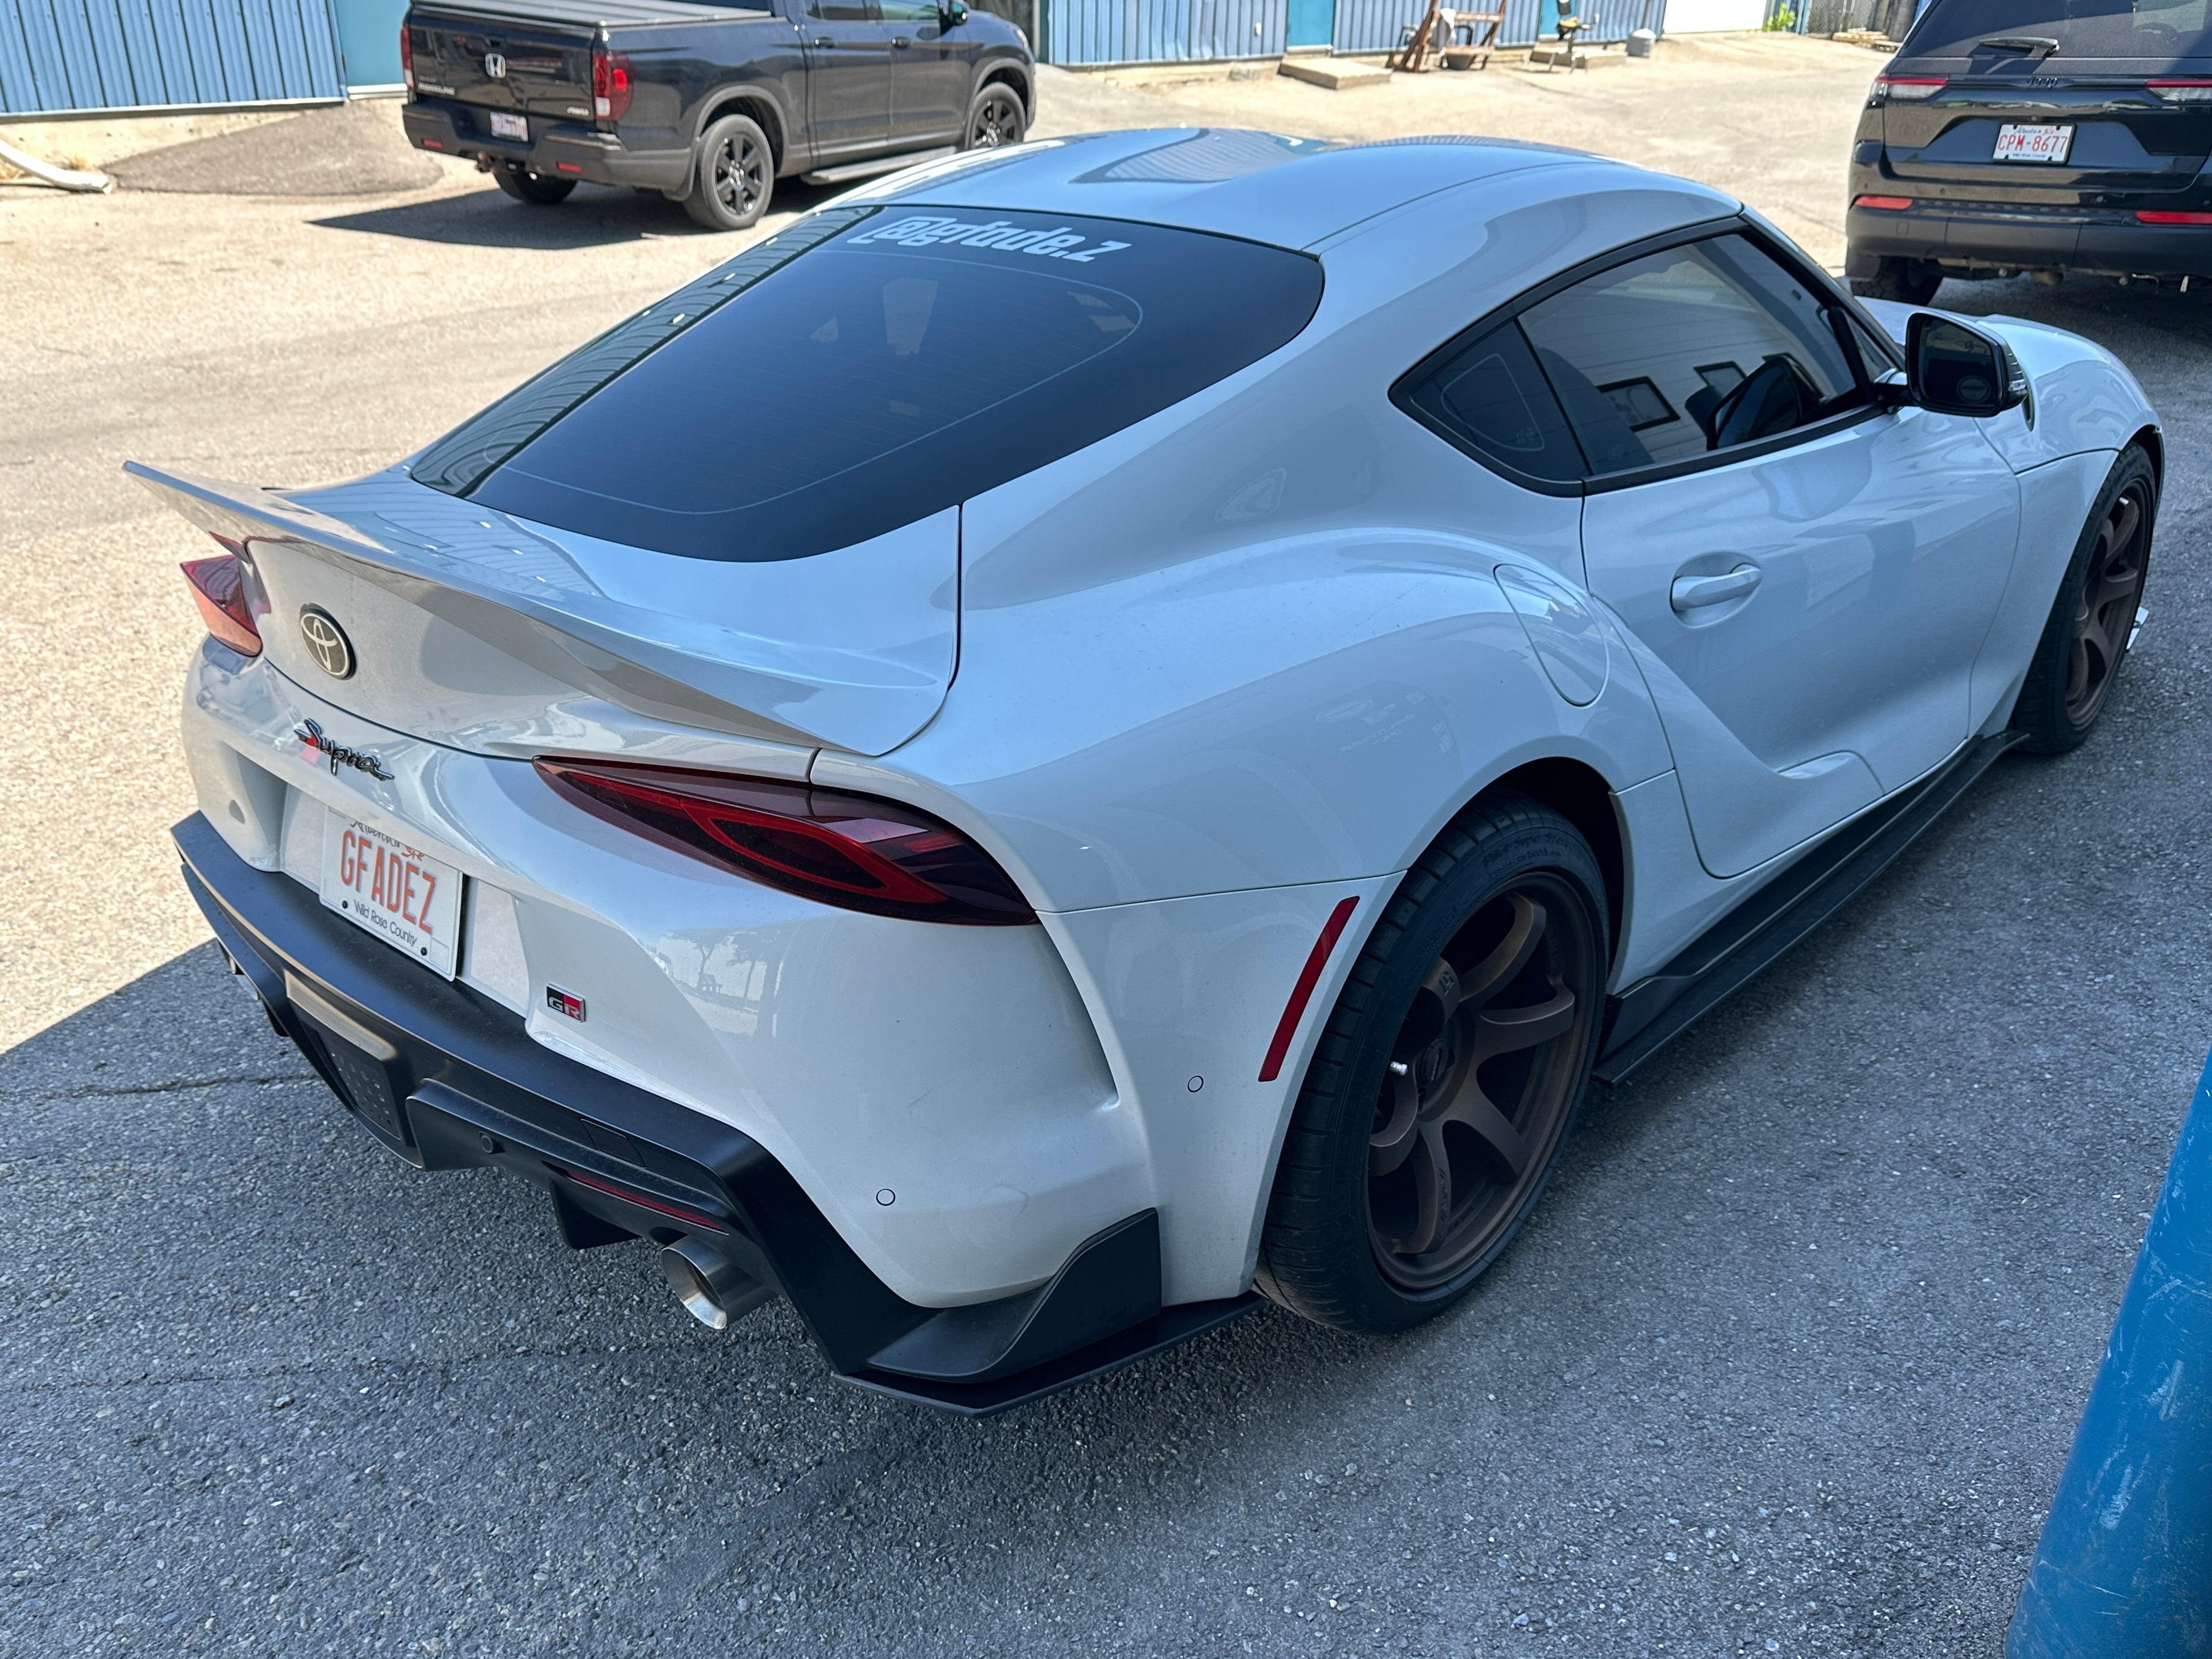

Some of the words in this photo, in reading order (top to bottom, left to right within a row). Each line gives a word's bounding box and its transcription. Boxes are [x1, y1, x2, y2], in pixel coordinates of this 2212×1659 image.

[2026, 75, 2058, 90] Jeep
[1997, 134, 2069, 153] CPM-8677
[846, 215, 1132, 263] @gfade.z
[294, 718, 395, 781] Supra
[340, 830, 436, 934] GFADEZ
[353, 899, 370, 919] Wild
[370, 910, 388, 929] Rose
[389, 922, 418, 948] Country
[549, 997, 579, 1020] GR
